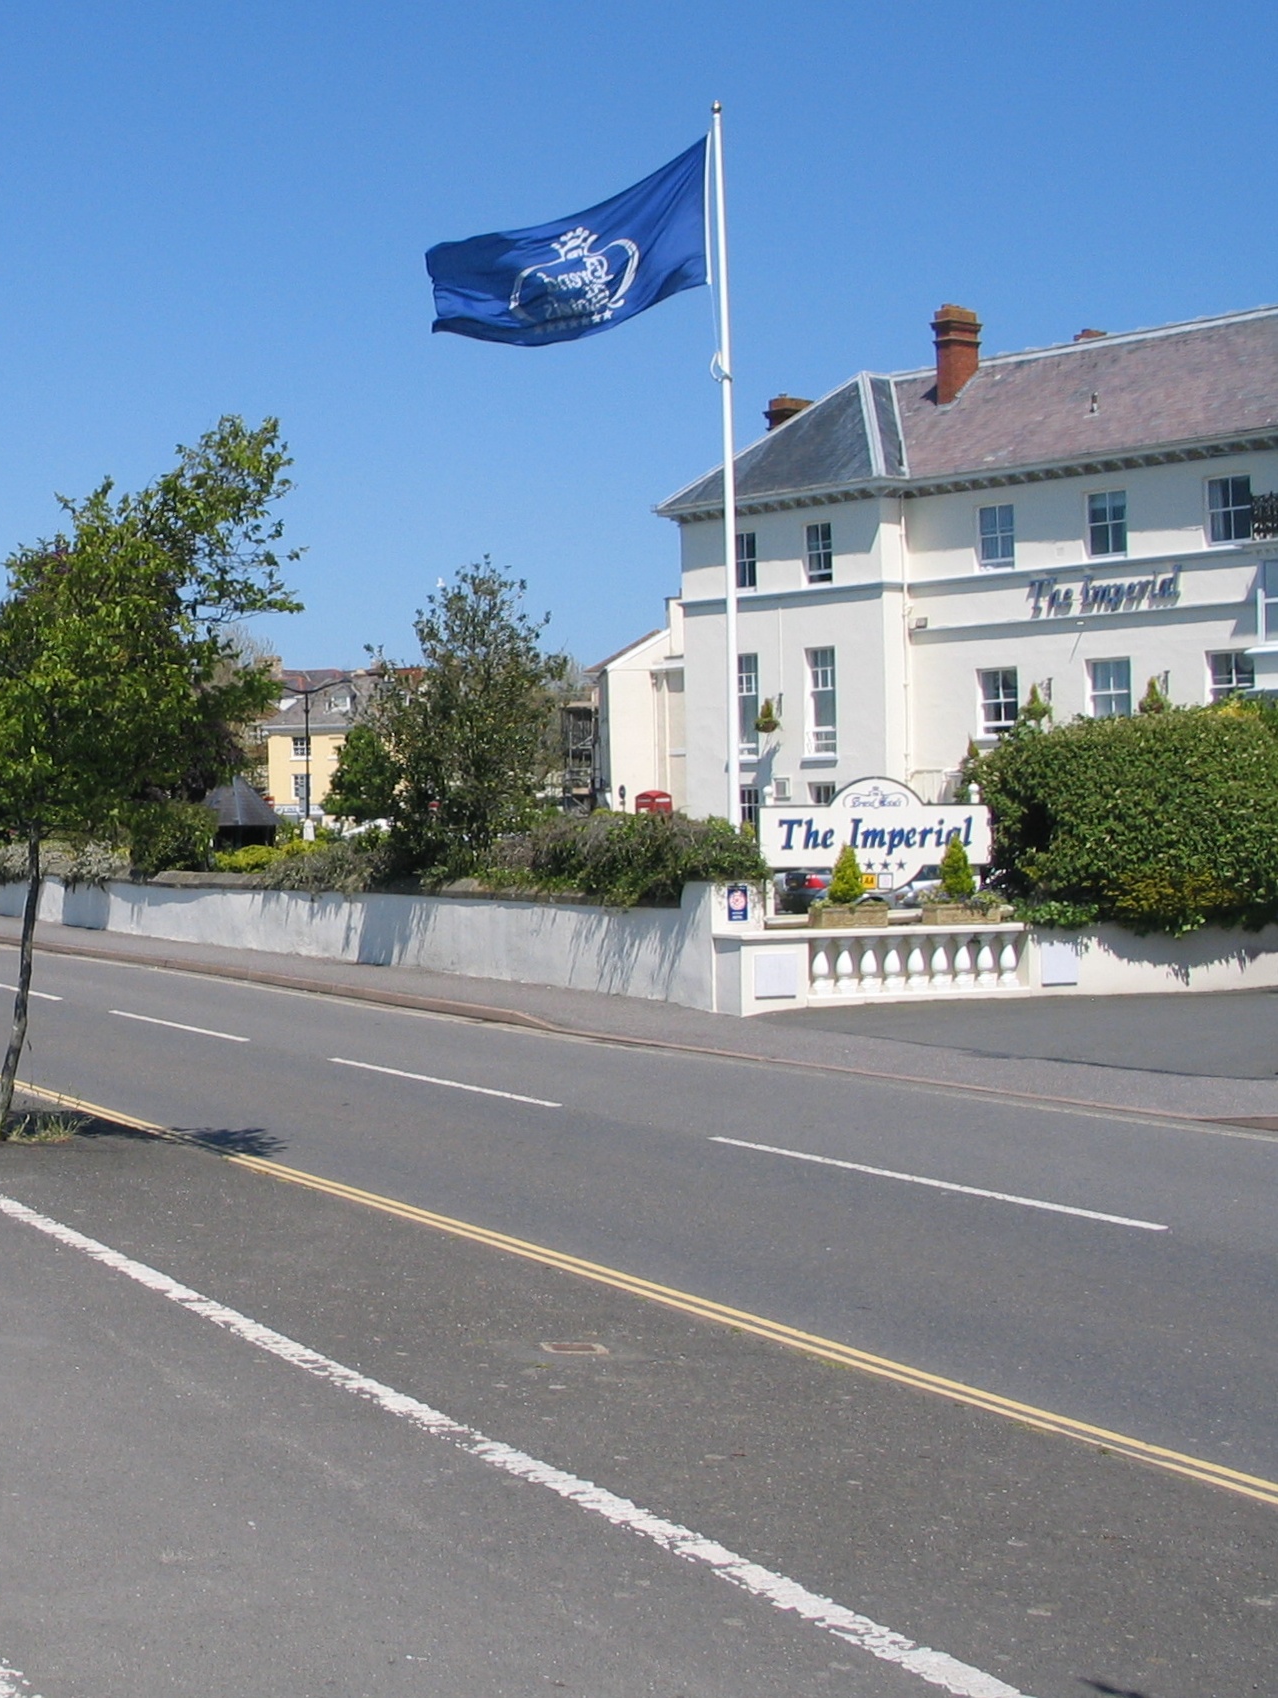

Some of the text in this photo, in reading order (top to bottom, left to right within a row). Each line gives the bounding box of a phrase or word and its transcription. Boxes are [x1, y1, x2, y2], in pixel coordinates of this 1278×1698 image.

[1029, 564, 1182, 612] The Imperial
[778, 815, 973, 856] The Imperial
